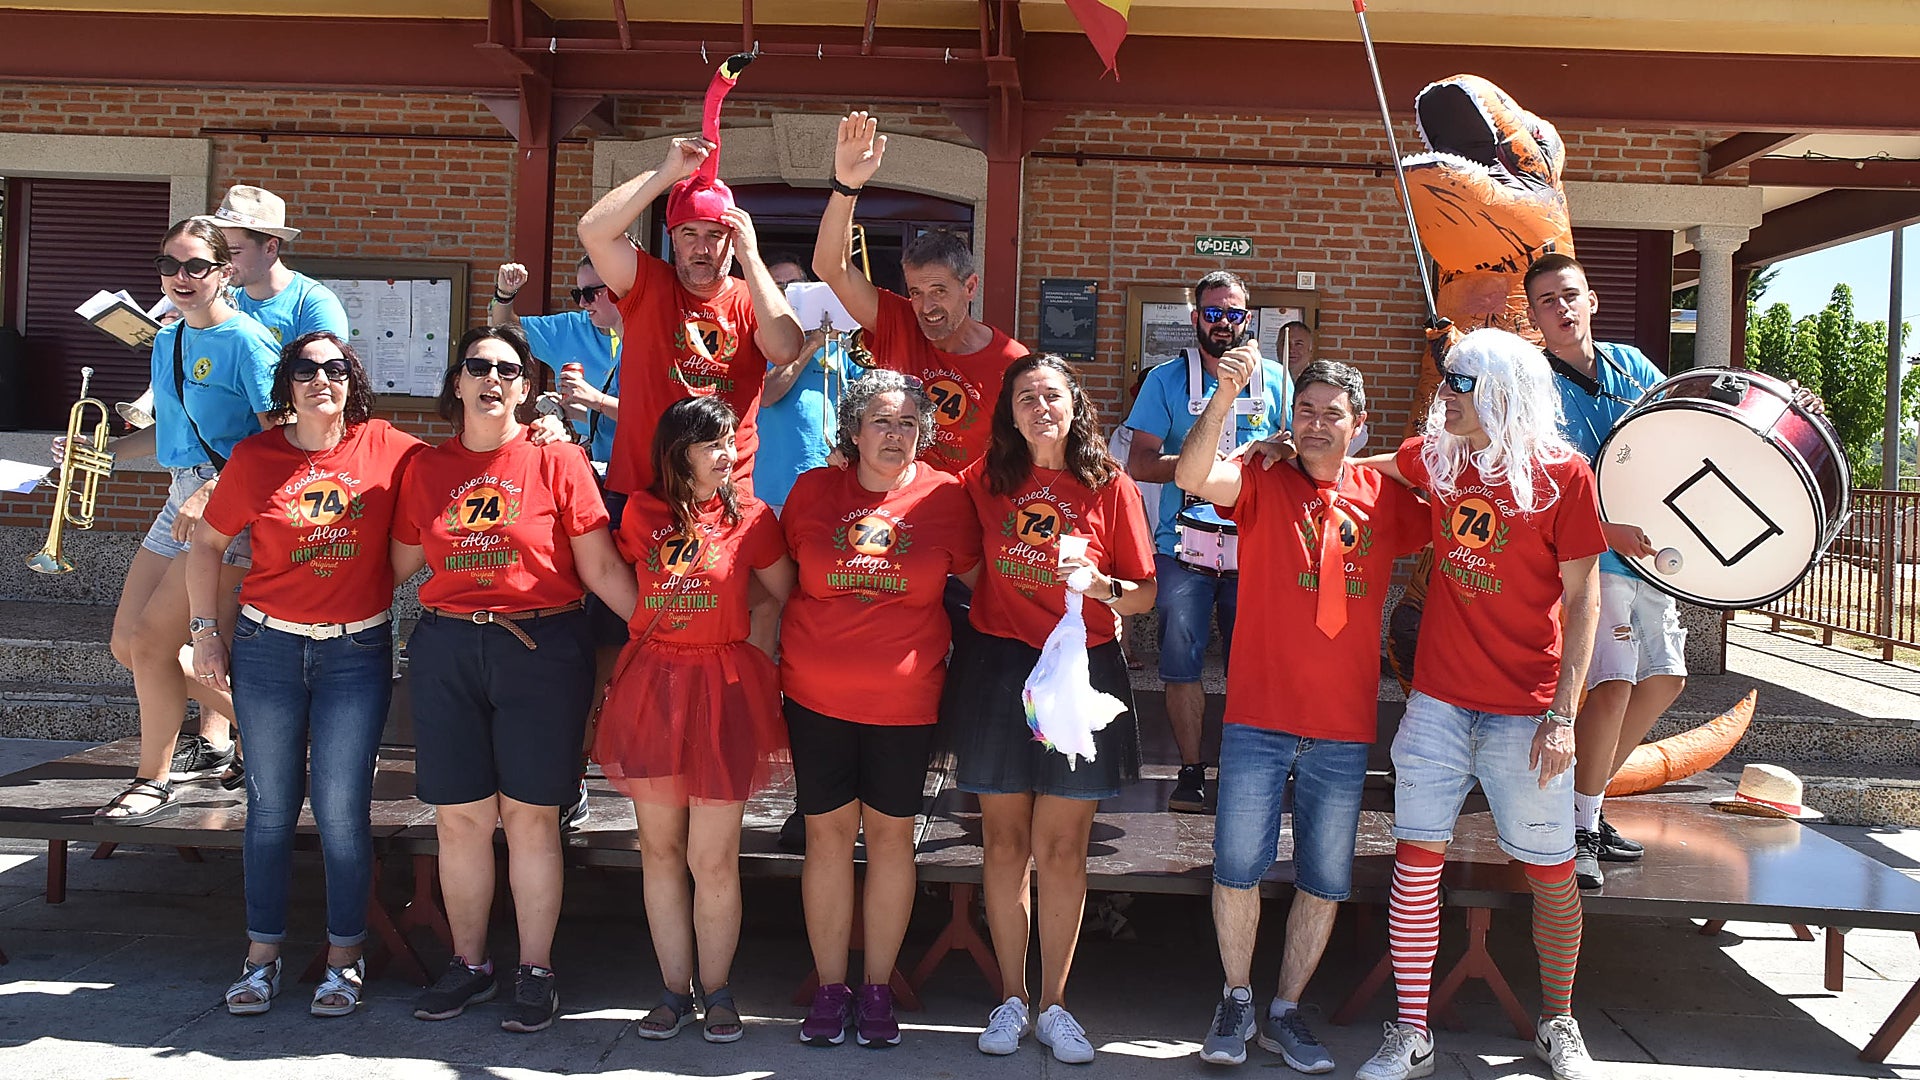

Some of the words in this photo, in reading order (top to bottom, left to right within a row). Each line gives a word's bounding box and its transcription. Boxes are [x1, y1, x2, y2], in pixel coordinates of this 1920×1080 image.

[1213, 241, 1240, 252] DEA
[682, 354, 721, 375] Algo
[930, 386, 962, 420] 74
[337, 471, 361, 488] del
[449, 472, 498, 499] Cosecha
[499, 479, 522, 495] del
[304, 490, 344, 518] 74
[466, 496, 500, 524] 74
[1057, 501, 1078, 520] del
[1494, 498, 1516, 518] del
[307, 525, 350, 543] Algo
[855, 523, 891, 547] 74
[1021, 511, 1056, 538] 74
[1457, 505, 1491, 542] 74
[460, 531, 502, 552] Algo
[666, 539, 701, 567] 74
[1008, 541, 1049, 565] Algo
[445, 550, 519, 570] IRREPETIBLE
[846, 554, 892, 574] Algo
[1448, 545, 1489, 570] Algo
[826, 573, 908, 592] IRREPETIBLE
[1297, 571, 1368, 596] IRRIBLE
